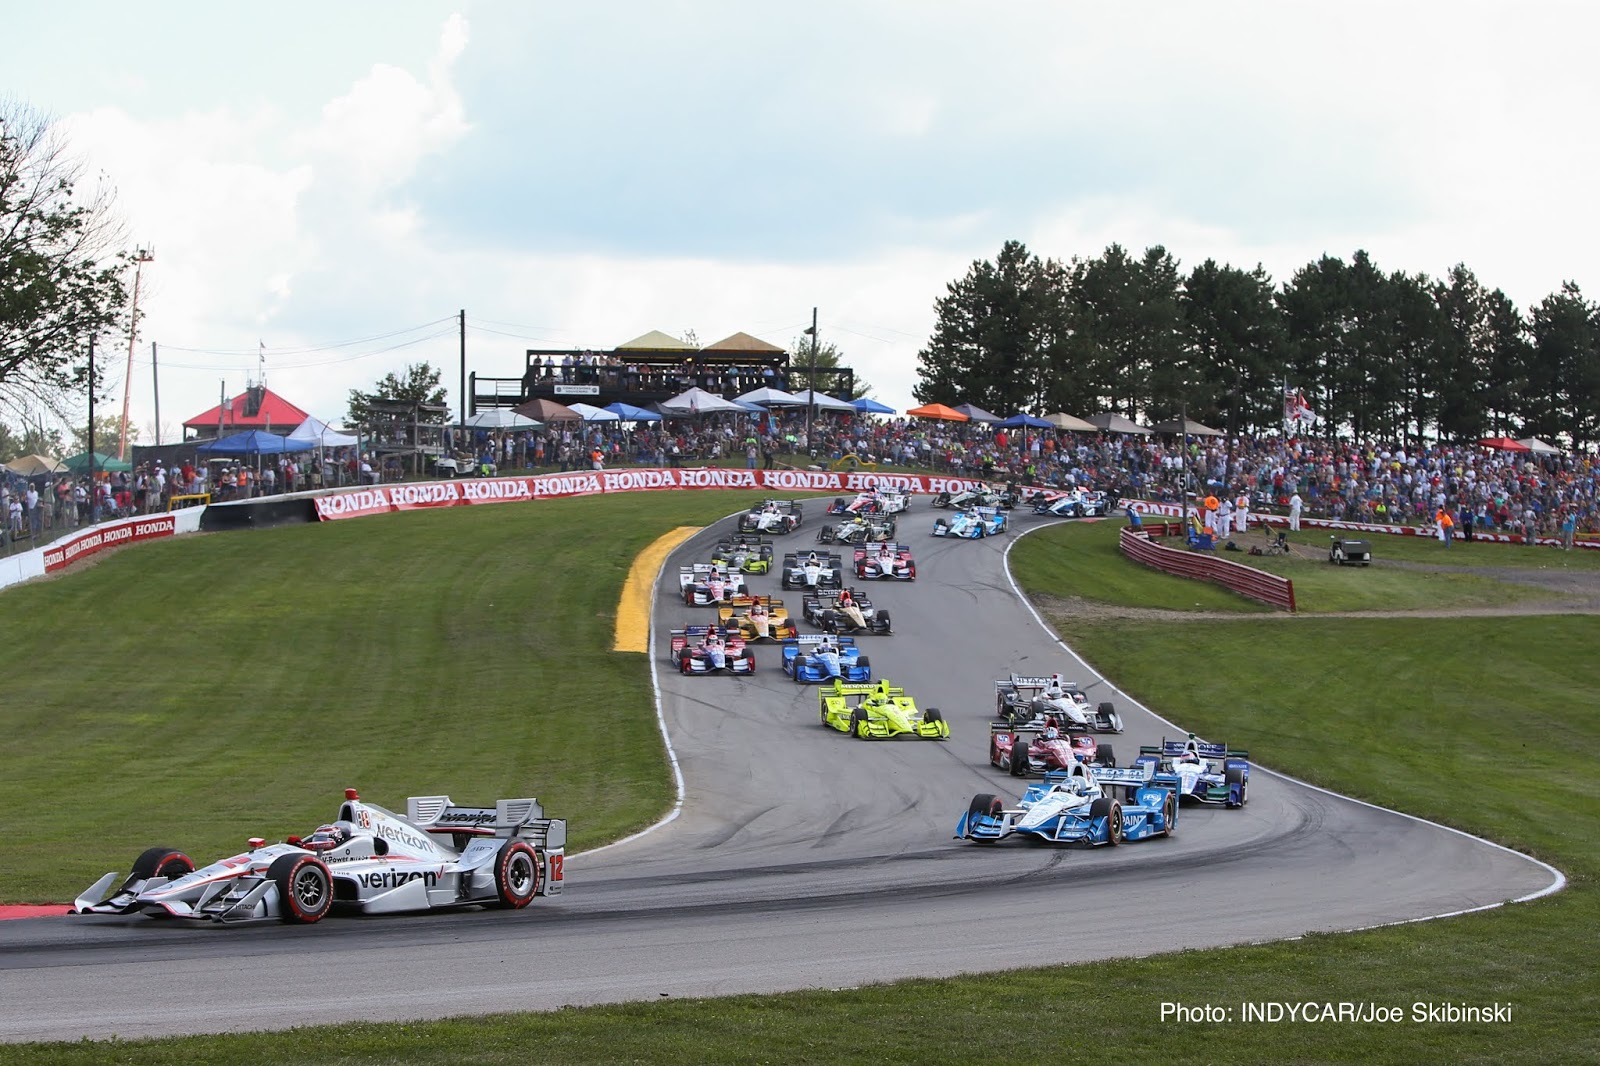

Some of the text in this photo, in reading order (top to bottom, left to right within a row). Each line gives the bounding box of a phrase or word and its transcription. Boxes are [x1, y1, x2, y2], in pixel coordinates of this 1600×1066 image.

[533, 474, 601, 495] HONDA
[603, 471, 677, 490] HONDA
[679, 470, 757, 488] HONDA
[763, 471, 842, 490] HONDA
[846, 474, 922, 493] HONDA
[929, 478, 980, 494] HON
[1179, 474, 1186, 489] 5
[390, 483, 459, 505] HONDA
[461, 479, 531, 500] HONDA
[318, 490, 390, 515] HONDA
[103, 527, 133, 543] HONDA
[135, 520, 174, 536] HONDA
[65, 543, 81, 559] HONDA
[80, 534, 102, 550] HONDA
[44, 550, 64, 567] HONDA
[376, 823, 433, 853] verizon
[550, 855, 563, 881] 12
[357, 868, 436, 888] verizon
